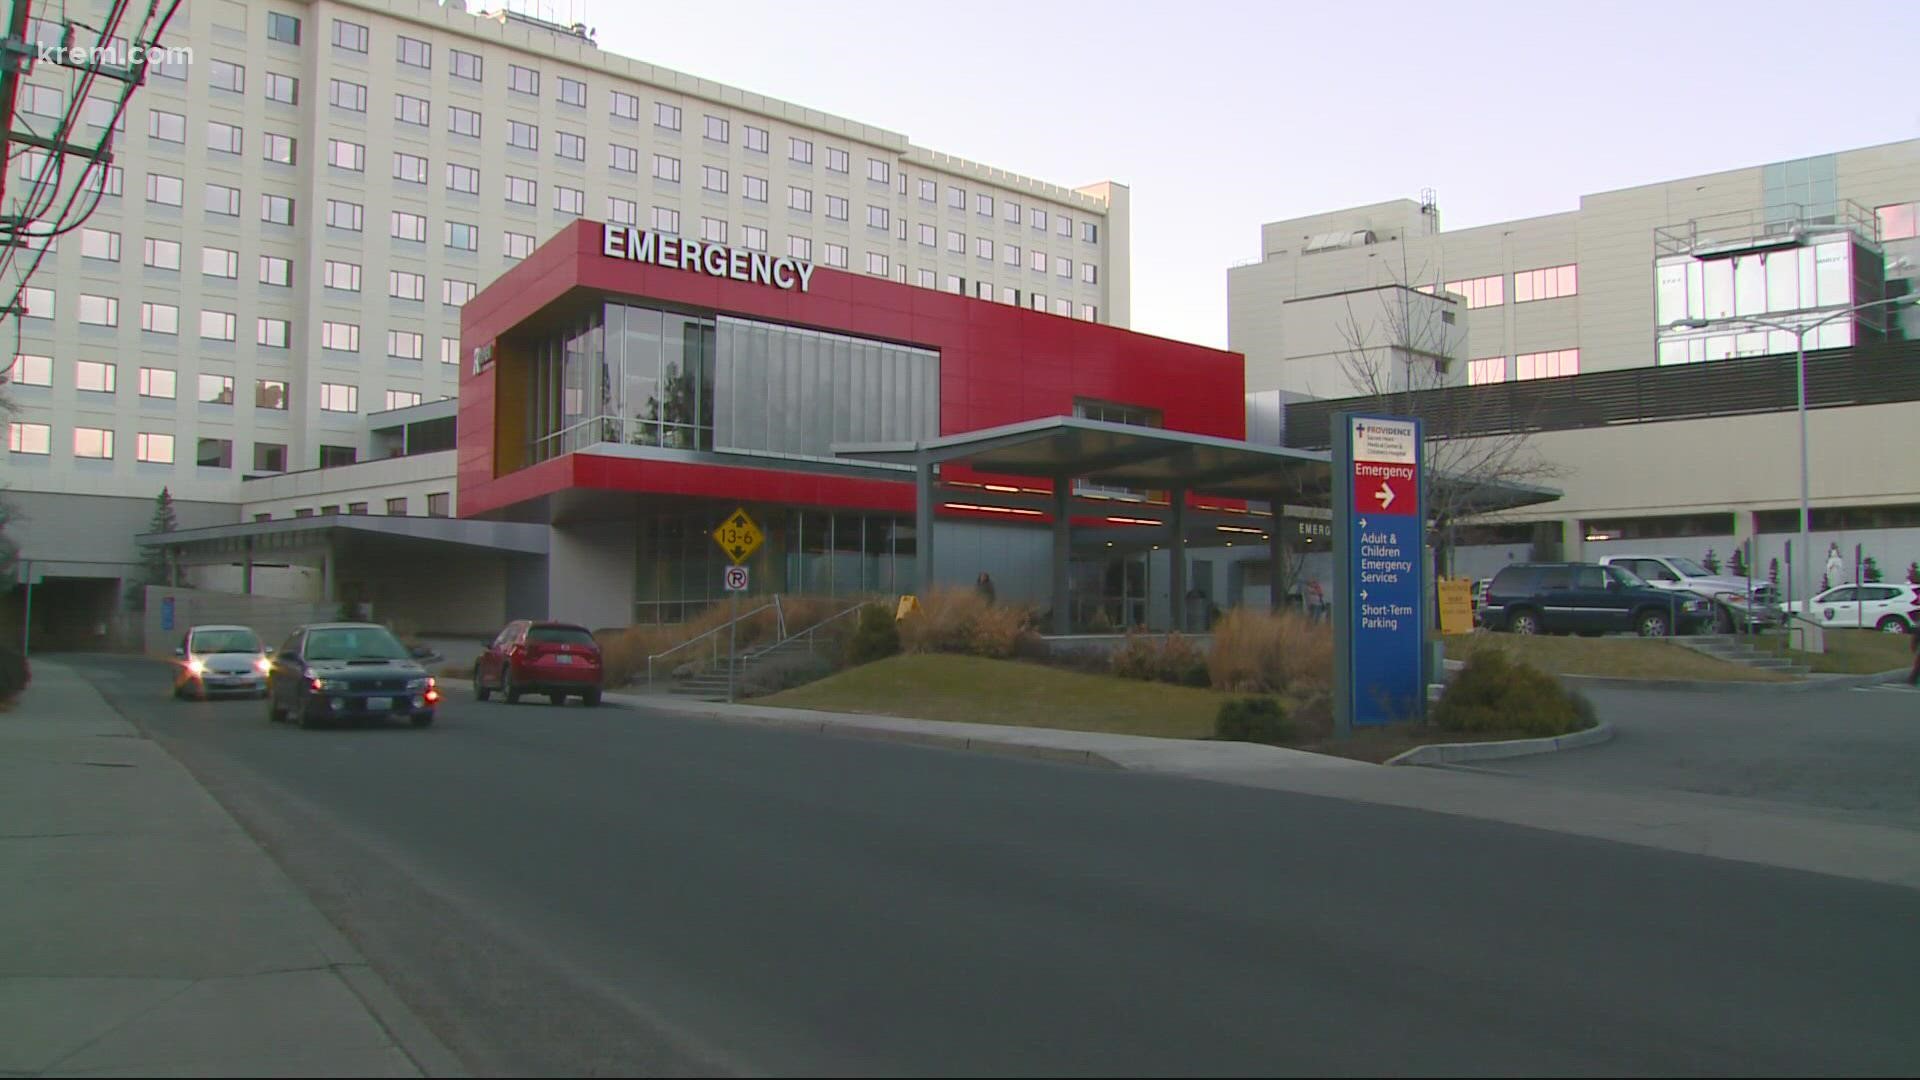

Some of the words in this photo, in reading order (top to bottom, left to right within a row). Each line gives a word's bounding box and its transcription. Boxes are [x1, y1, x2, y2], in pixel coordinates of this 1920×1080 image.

[603, 223, 815, 292] EMERGENCY
[1367, 426, 1411, 436] PROVIDENCE
[1355, 463, 1413, 480] Emergency
[721, 529, 753, 545] 13-6
[1361, 533, 1387, 544] Adult
[1389, 534, 1397, 545] &
[1361, 545, 1400, 557] Children
[1361, 558, 1411, 573] Emergency
[1361, 572, 1397, 583] Services
[1362, 604, 1412, 616] Short-Term
[1362, 617, 1397, 631] Parking
